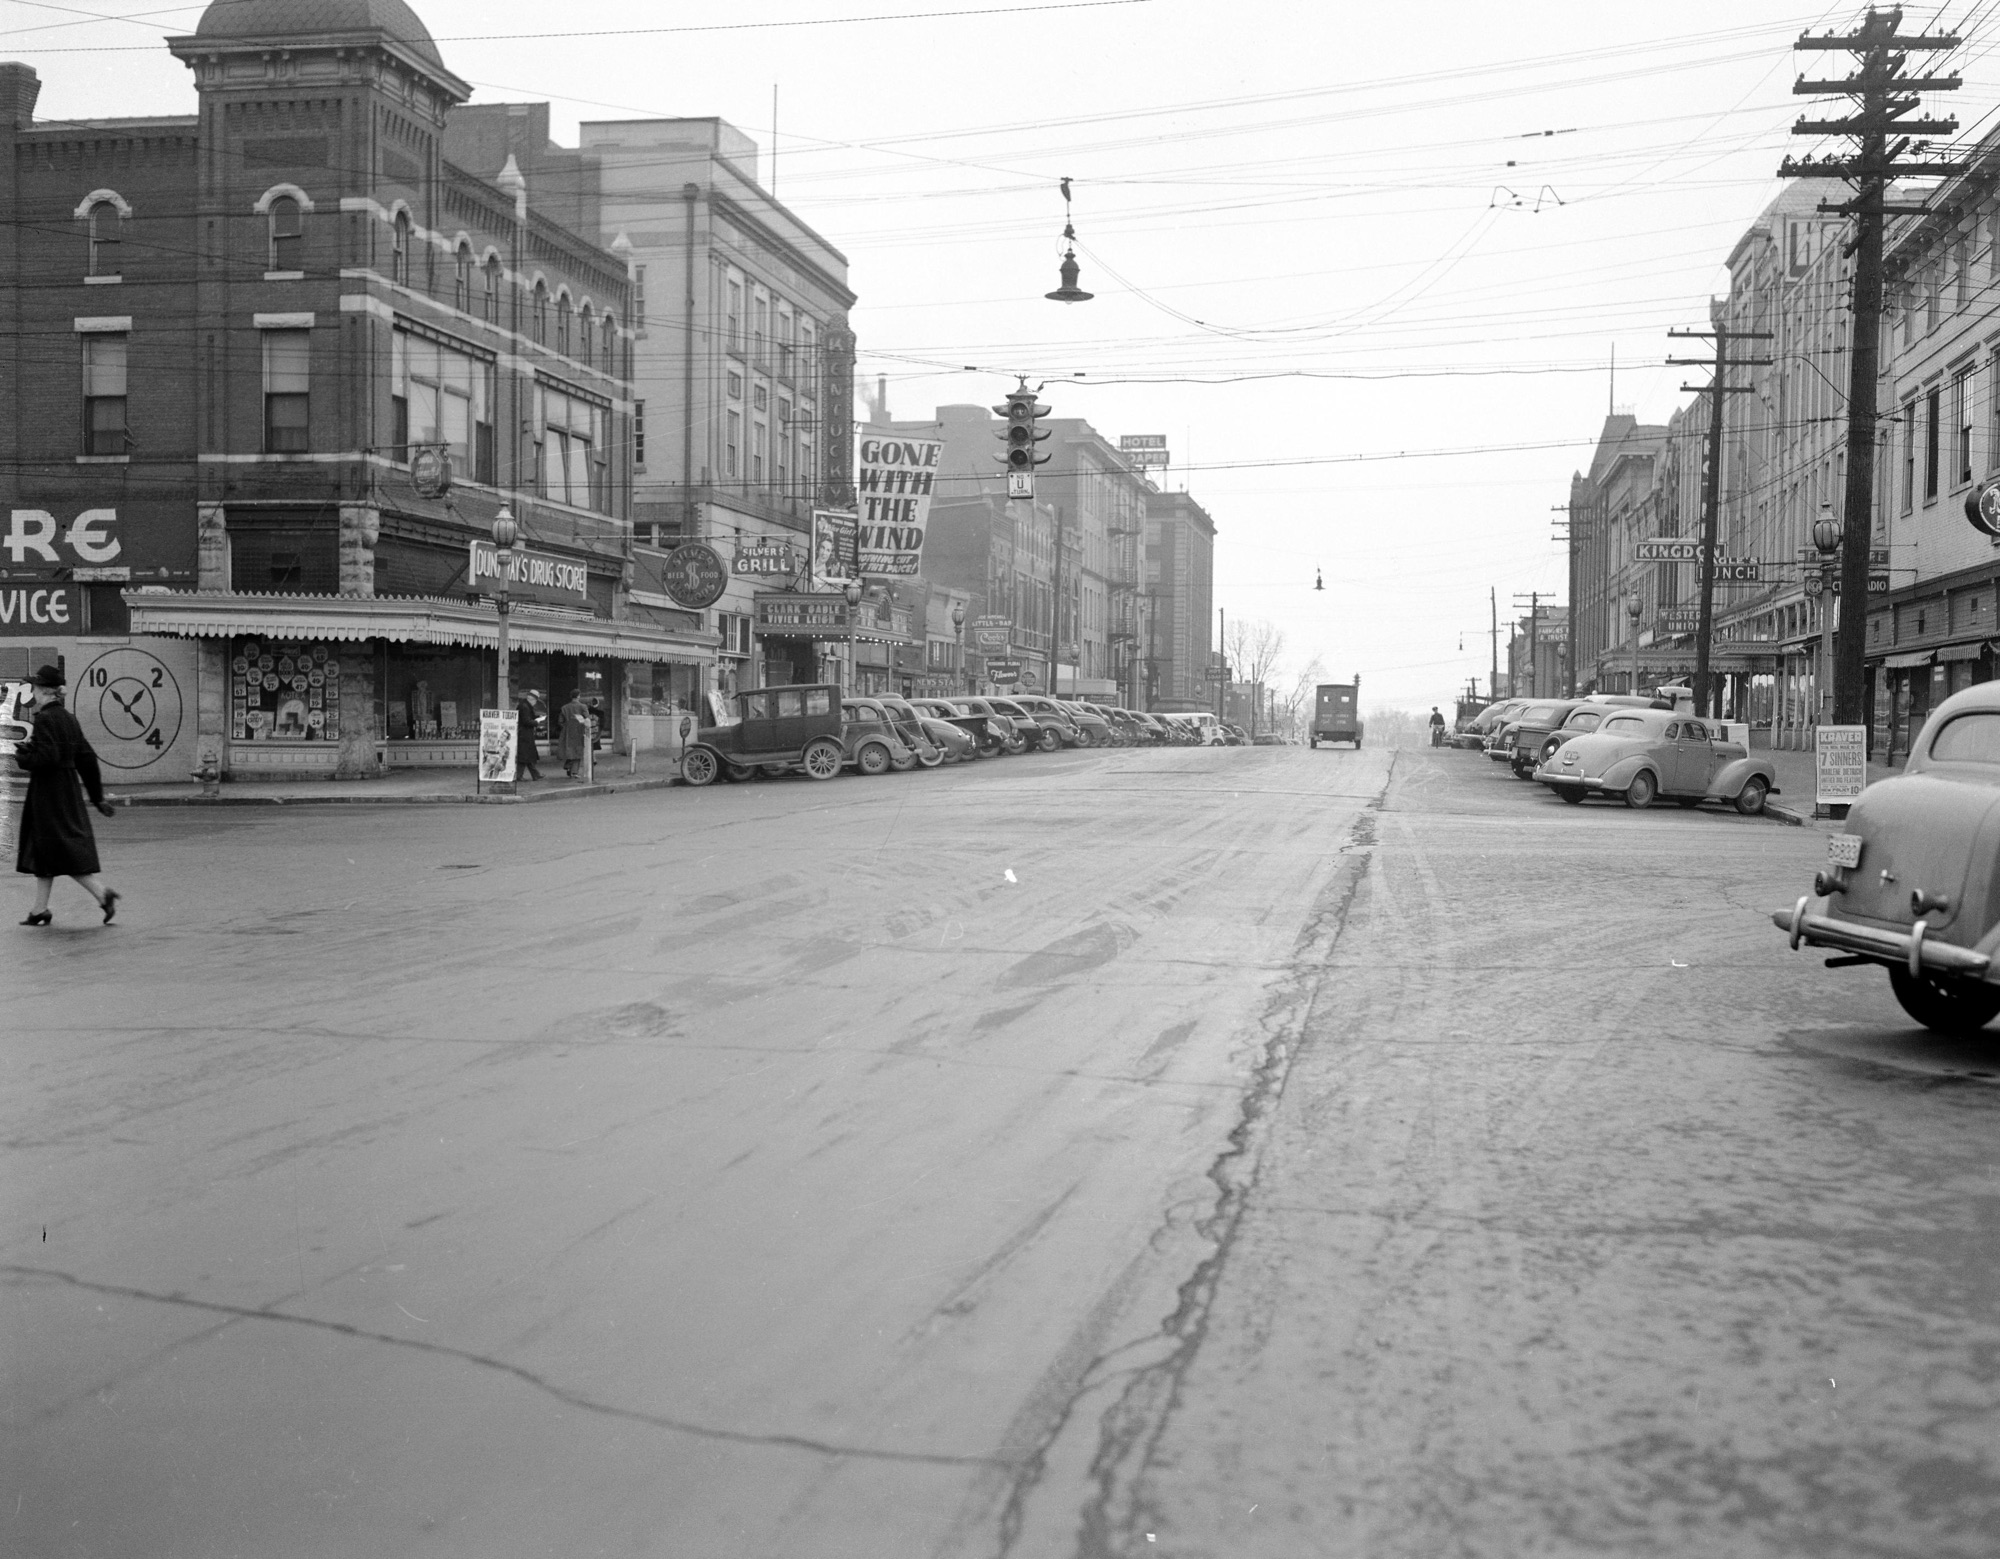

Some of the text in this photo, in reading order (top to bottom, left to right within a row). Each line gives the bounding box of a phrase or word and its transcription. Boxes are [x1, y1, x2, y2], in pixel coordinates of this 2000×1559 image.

[1122, 437, 1164, 447] HOTEL
[861, 440, 942, 467] GONE
[1130, 453, 1167, 463] OAPER
[859, 468, 935, 495] WITH
[1017, 479, 1024, 489] U
[864, 496, 919, 522] THE
[896, 555, 914, 564] CUT
[737, 558, 790, 572] GRILL
[867, 563, 882, 571] THE
[476, 549, 584, 592] DUNAY'S DRUG STORE
[700, 571, 719, 579] FOOD
[1867, 580, 1887, 592] ADIO
[767, 604, 840, 614] CLARK GABLE
[768, 614, 799, 624] VIVIEN
[1661, 611, 1701, 620] WESTER
[89, 668, 163, 688] 10 2
[917, 679, 964, 687] NEWS STAD
[502, 711, 518, 720] TODAY
[145, 728, 163, 750] 4
[1820, 732, 1862, 742] KRAVER
[1820, 751, 1862, 766] 7 SINNERS
